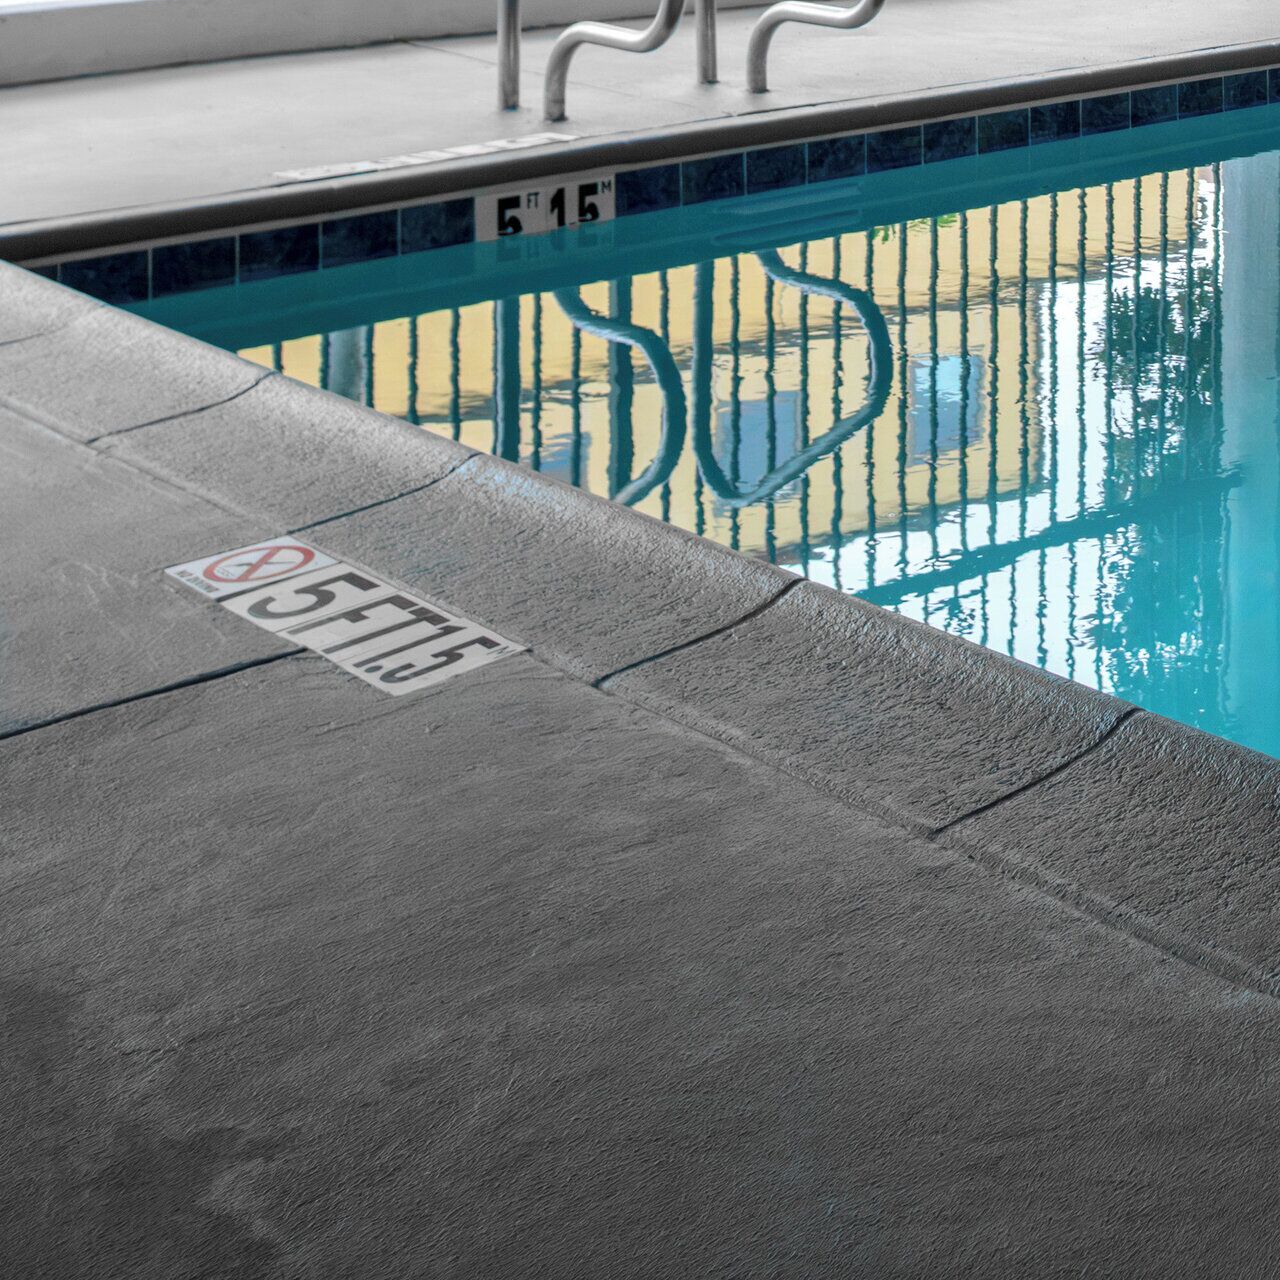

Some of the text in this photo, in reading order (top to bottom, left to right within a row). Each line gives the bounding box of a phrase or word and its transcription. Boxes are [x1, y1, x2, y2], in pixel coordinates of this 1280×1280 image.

[498, 195, 523, 236] 5
[527, 192, 540, 209] FT
[601, 179, 612, 194] M
